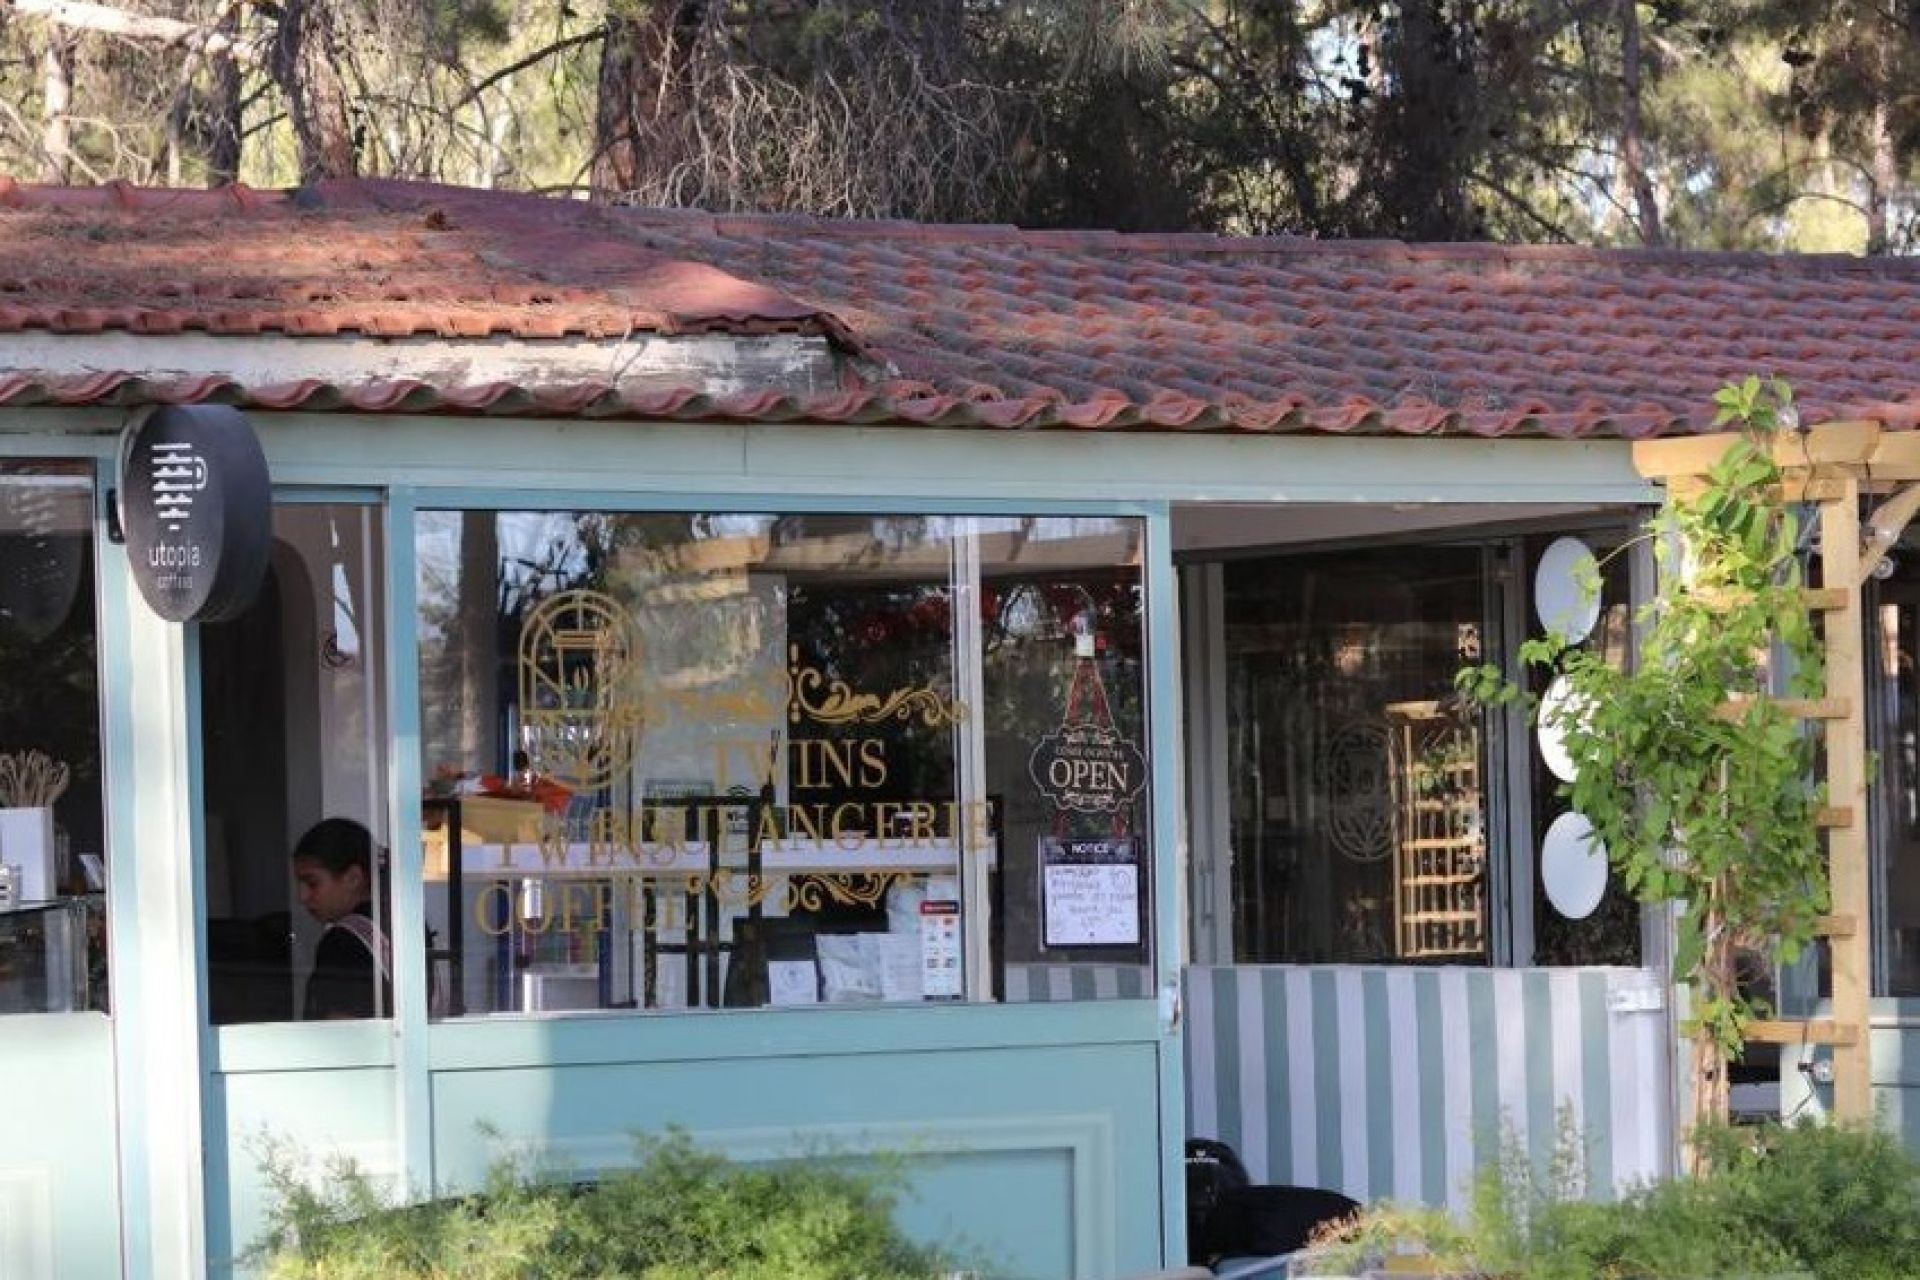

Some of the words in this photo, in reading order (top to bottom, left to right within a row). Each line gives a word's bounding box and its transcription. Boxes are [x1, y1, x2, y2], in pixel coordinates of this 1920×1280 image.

[148, 539, 200, 570] utopia
[712, 739, 887, 788] TWINS
[1049, 758, 1129, 792] OPEN
